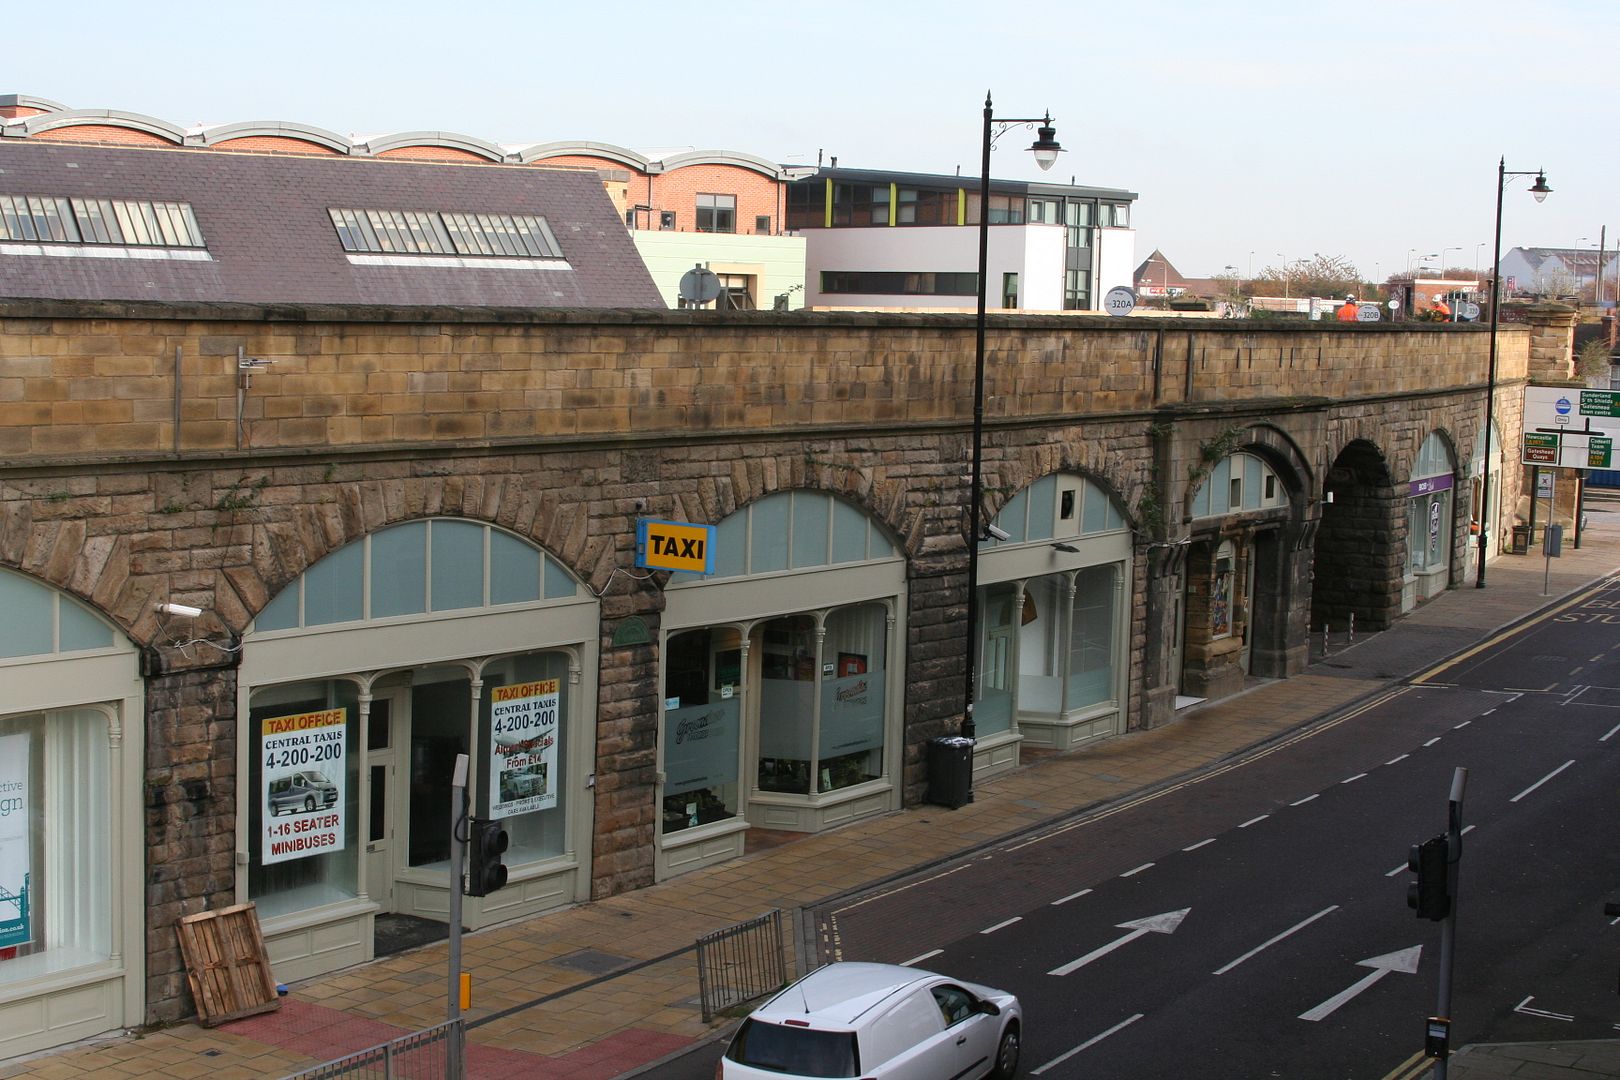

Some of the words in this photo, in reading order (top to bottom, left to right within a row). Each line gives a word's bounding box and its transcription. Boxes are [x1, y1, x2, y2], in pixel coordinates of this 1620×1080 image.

[1112, 300, 1132, 308] 320A
[650, 534, 704, 560] TAXI
[497, 688, 518, 701] TAXI
[521, 682, 556, 698] OFFICE
[495, 703, 531, 716] CENTRAL
[533, 699, 556, 710] TAXIS
[268, 718, 295, 734] TAXI
[298, 712, 341, 730] OFFICE
[495, 710, 555, 733] 4-200-200
[266, 734, 311, 750] CENTRAL
[313, 731, 342, 744] TAXIS
[266, 743, 341, 769] 4-200-200
[507, 757, 526, 769] From
[528, 755, 542, 765] £14
[268, 823, 291, 838] 1-16
[294, 814, 339, 833] SEATER
[272, 832, 336, 855] MINIBUSES
